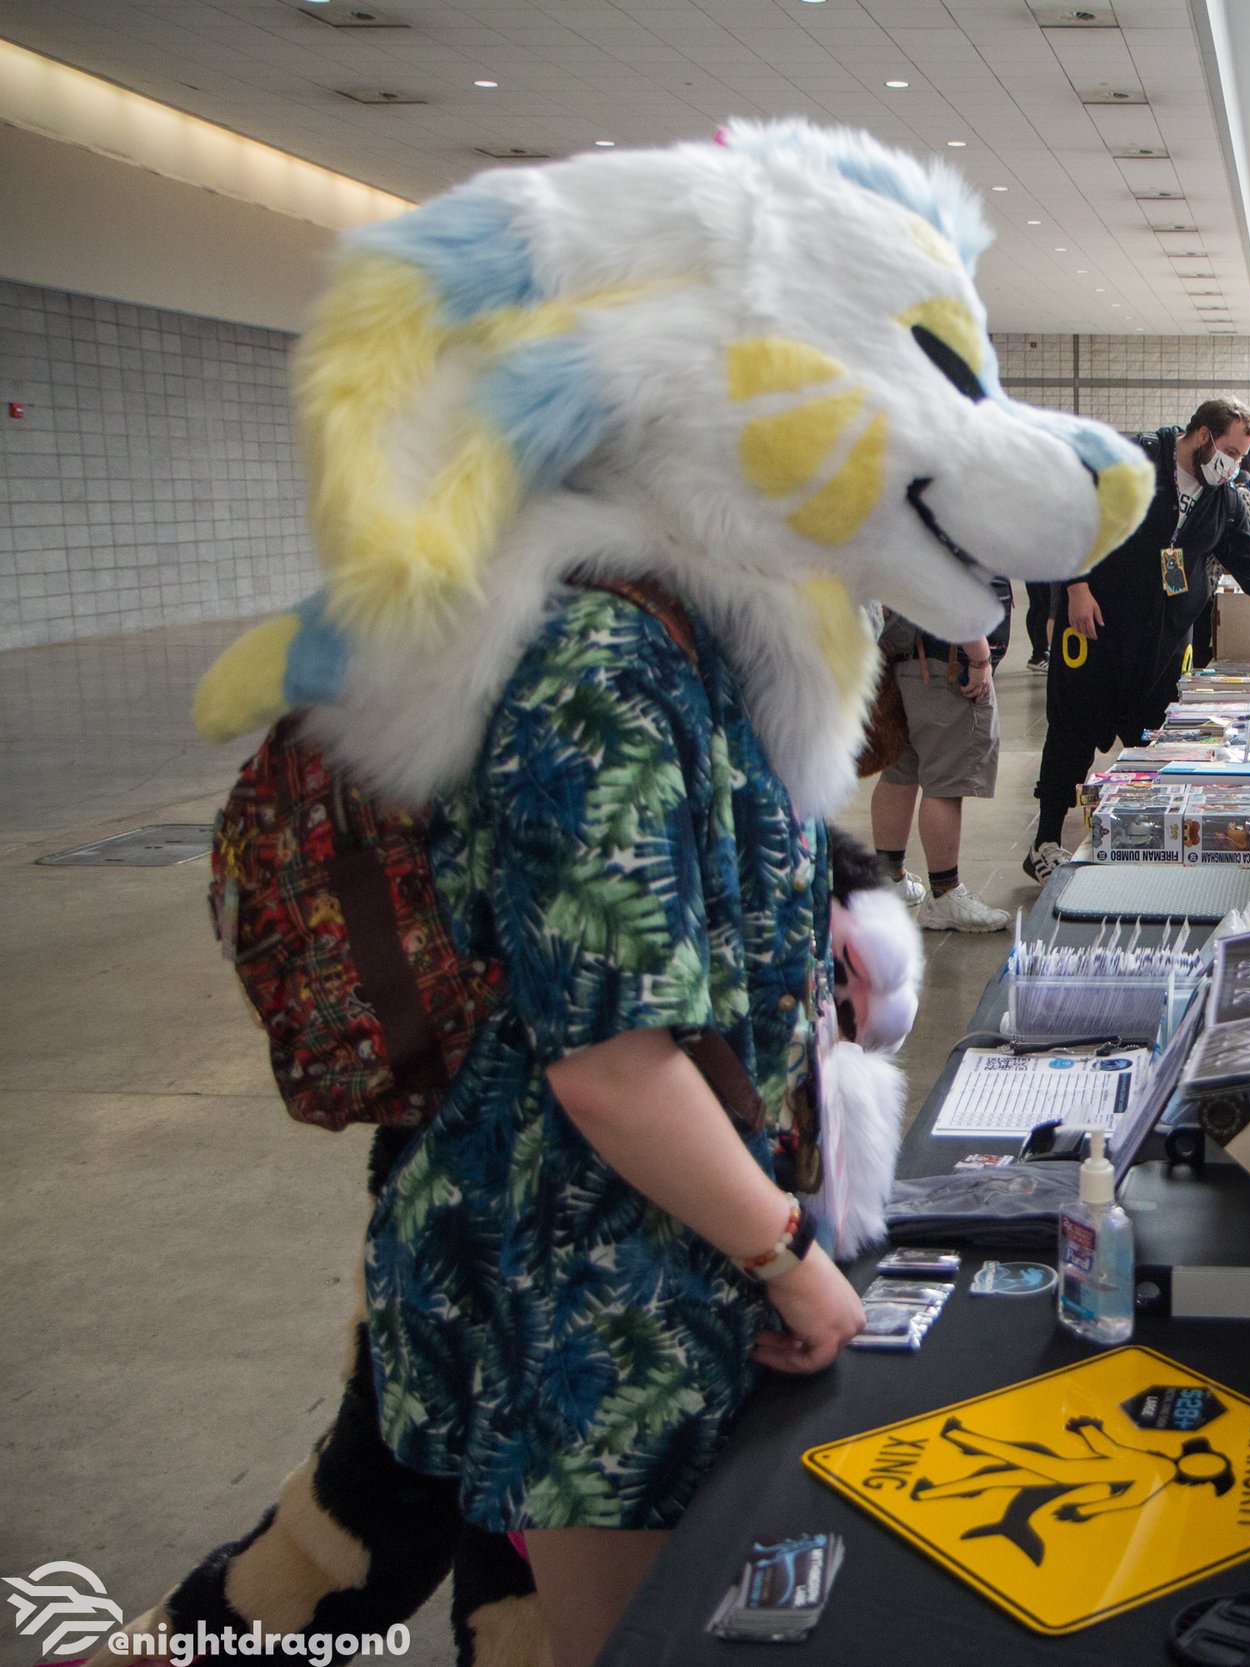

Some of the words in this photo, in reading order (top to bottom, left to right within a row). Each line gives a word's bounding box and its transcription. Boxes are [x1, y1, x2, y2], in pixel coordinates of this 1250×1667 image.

[1110, 850, 1140, 862] DUMBO
[1144, 850, 1179, 862] FIREMAN
[1201, 852, 1241, 864] CUNNINGHAM
[1174, 1388, 1203, 1429] $28+
[862, 1435, 930, 1490] XING
